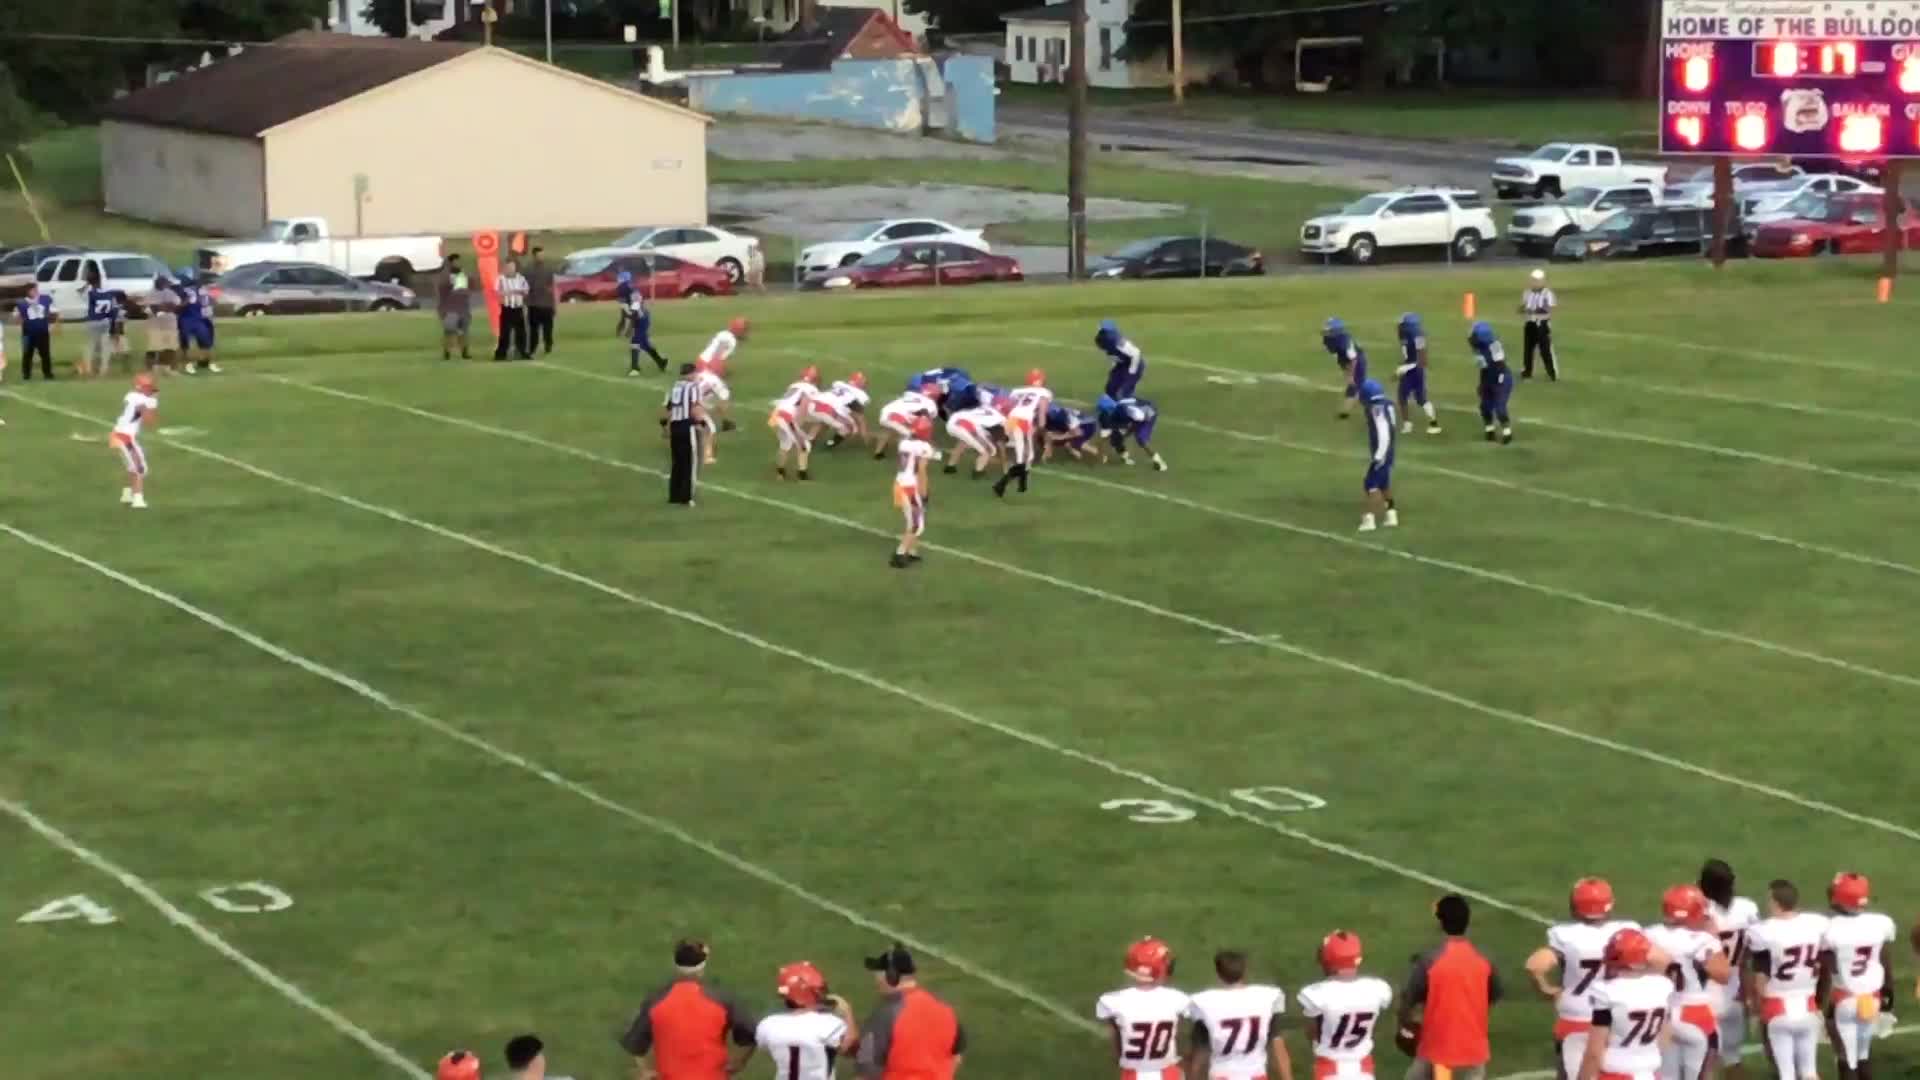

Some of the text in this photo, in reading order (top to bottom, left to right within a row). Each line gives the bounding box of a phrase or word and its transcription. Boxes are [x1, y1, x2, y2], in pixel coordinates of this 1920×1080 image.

[1667, 17, 1729, 36] HOME
[1738, 17, 1764, 36] OF
[1774, 17, 1817, 36] THE
[1665, 42, 1715, 59] HOME
[1668, 101, 1711, 114] DOWN
[1775, 946, 1822, 981] 24
[1851, 945, 1873, 978] 3
[1125, 1020, 1175, 1060] 30
[1219, 1015, 1261, 1055] 71
[1330, 1012, 1375, 1049] 15
[1620, 1007, 1666, 1047] 70
